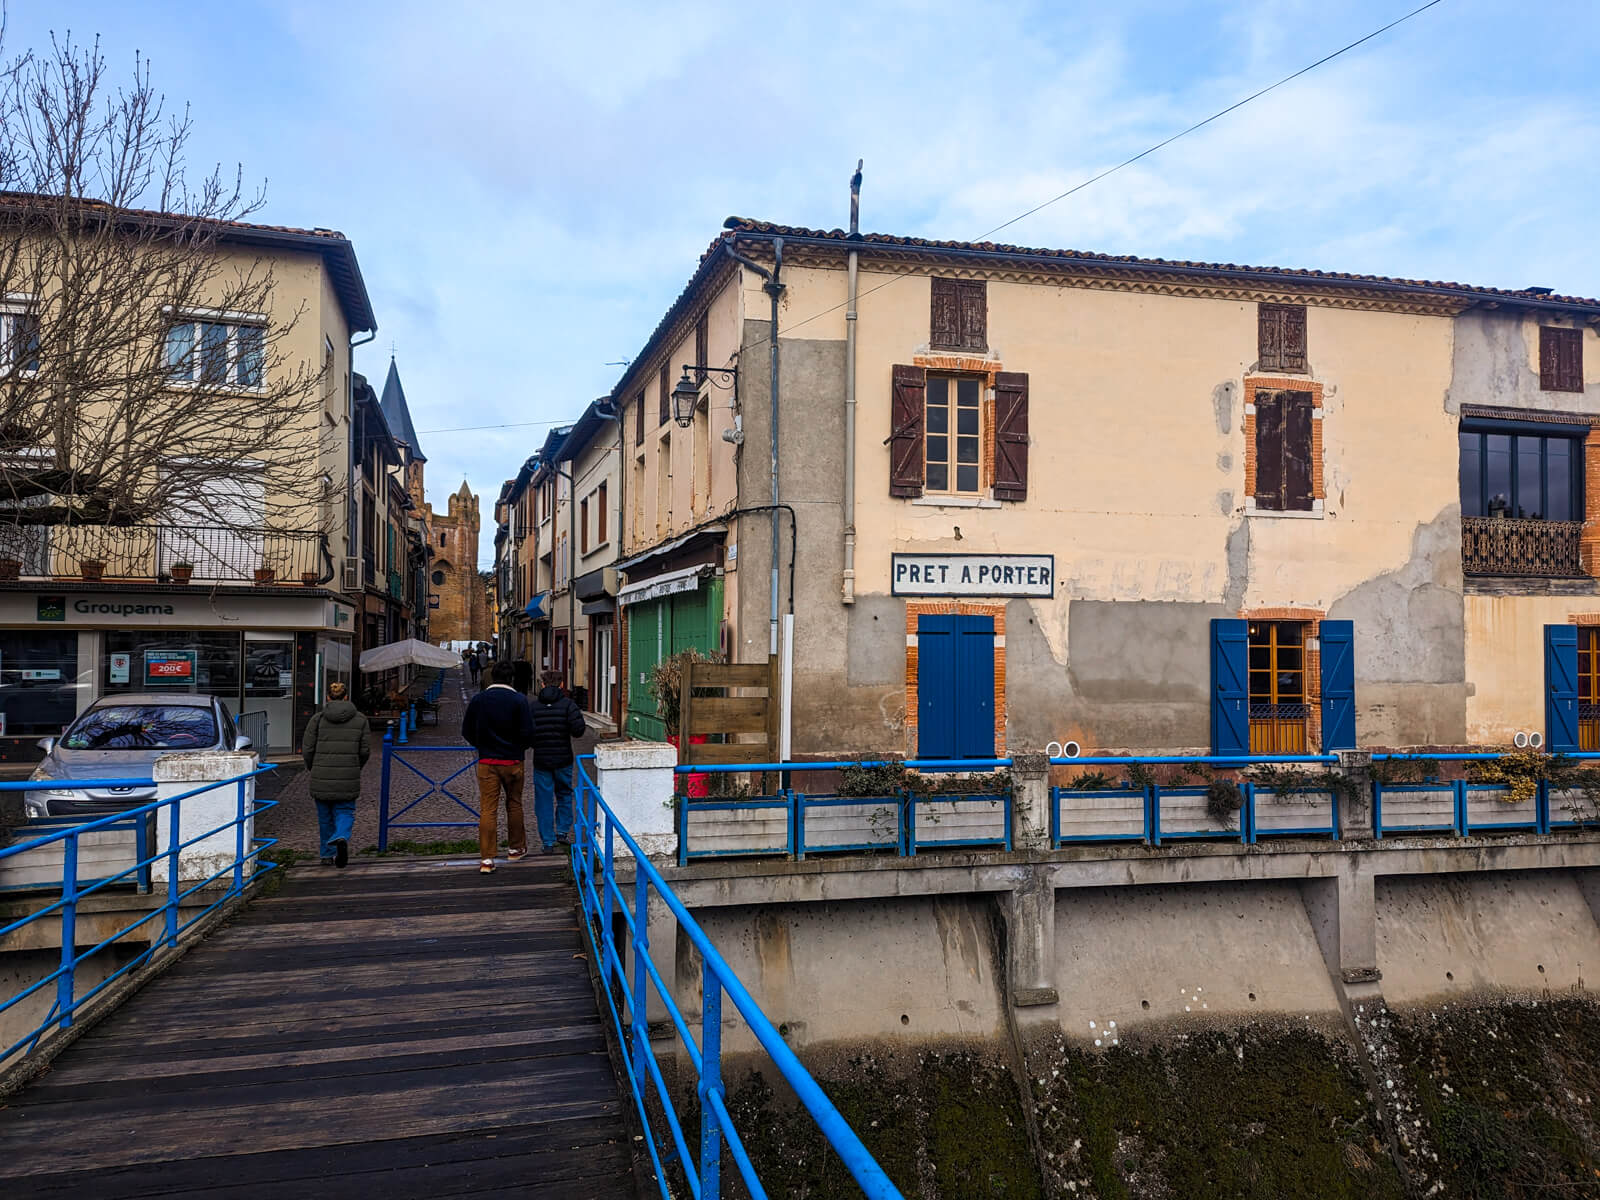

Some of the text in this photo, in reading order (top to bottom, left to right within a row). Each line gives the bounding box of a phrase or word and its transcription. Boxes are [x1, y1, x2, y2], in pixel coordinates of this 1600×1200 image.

[896, 563, 950, 584] PRET
[961, 565, 972, 584] A
[978, 565, 1050, 586] PORTER
[74, 599, 174, 617] Groupama
[158, 665, 182, 673] 200€
